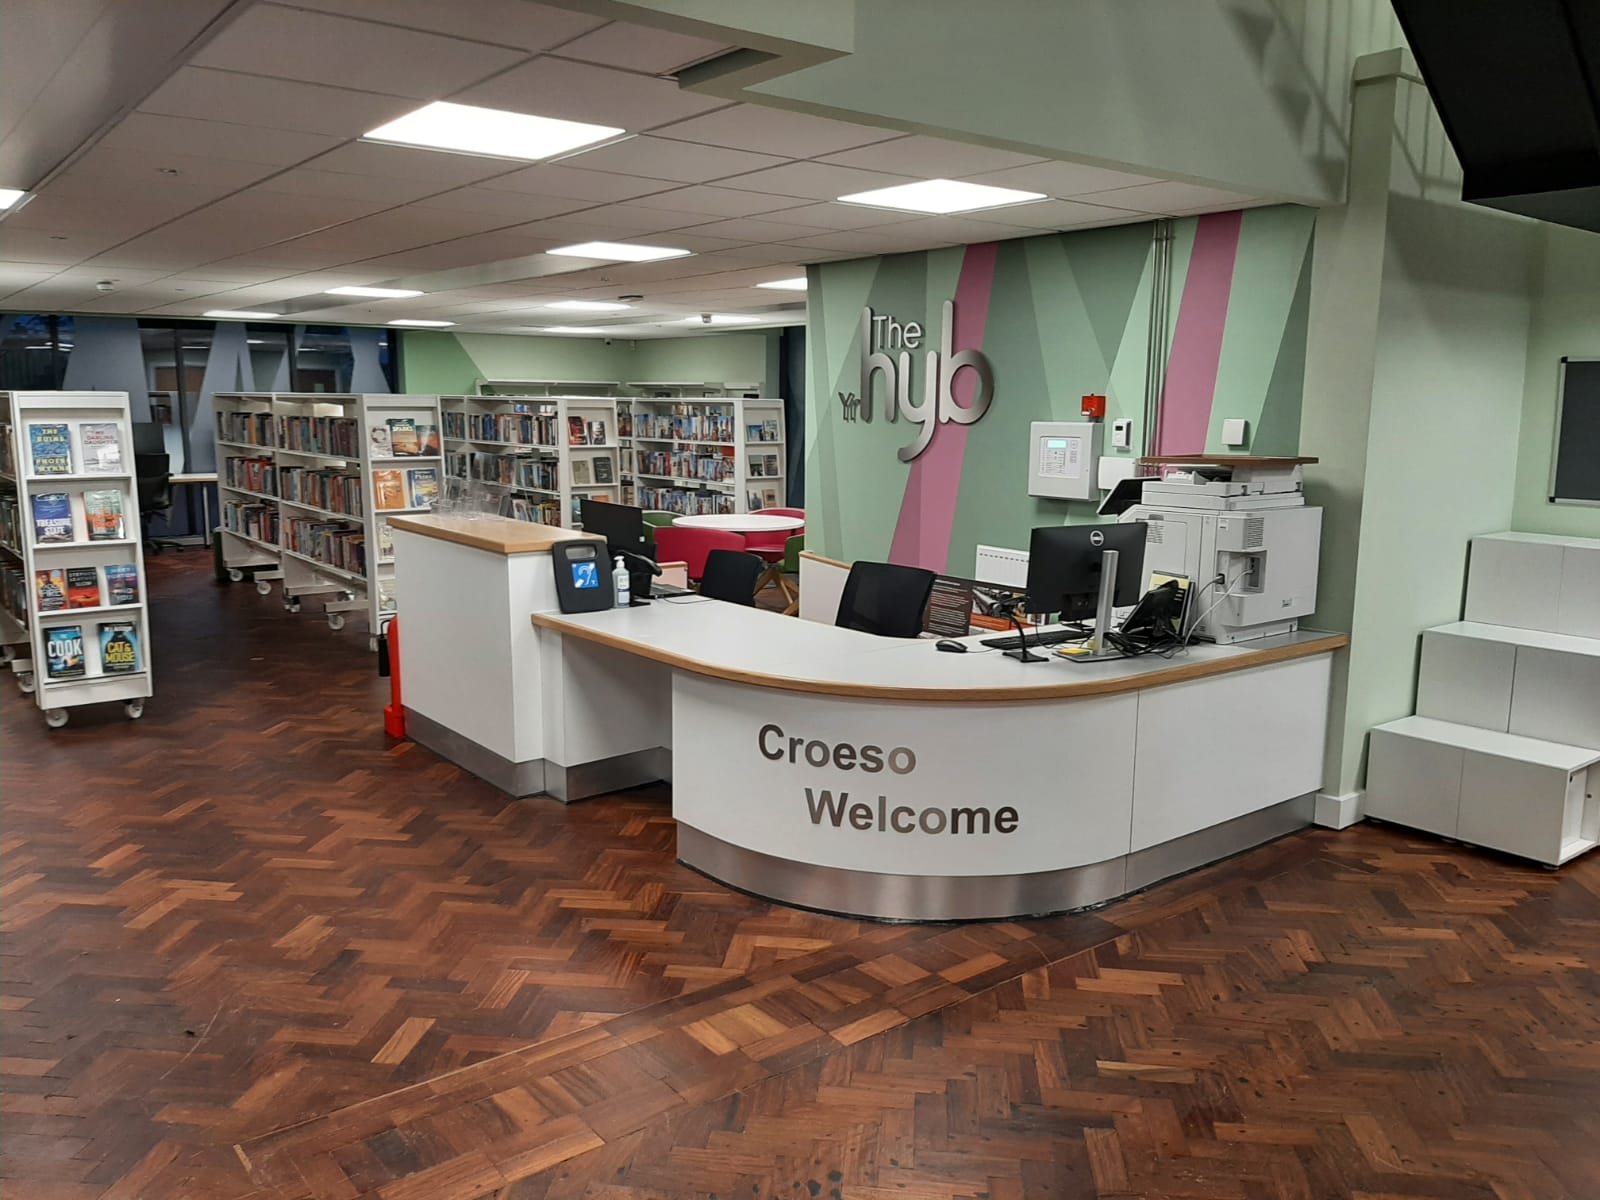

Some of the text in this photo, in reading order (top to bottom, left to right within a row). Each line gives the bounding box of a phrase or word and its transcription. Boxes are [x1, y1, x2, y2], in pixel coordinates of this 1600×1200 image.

[872, 315, 922, 349] The
[860, 300, 995, 463] hyb
[47, 638, 83, 657] COOK
[105, 652, 136, 663] MOUSE
[107, 641, 125, 653] CAT
[758, 724, 917, 775] Croeso
[804, 788, 1019, 835] Welcome
